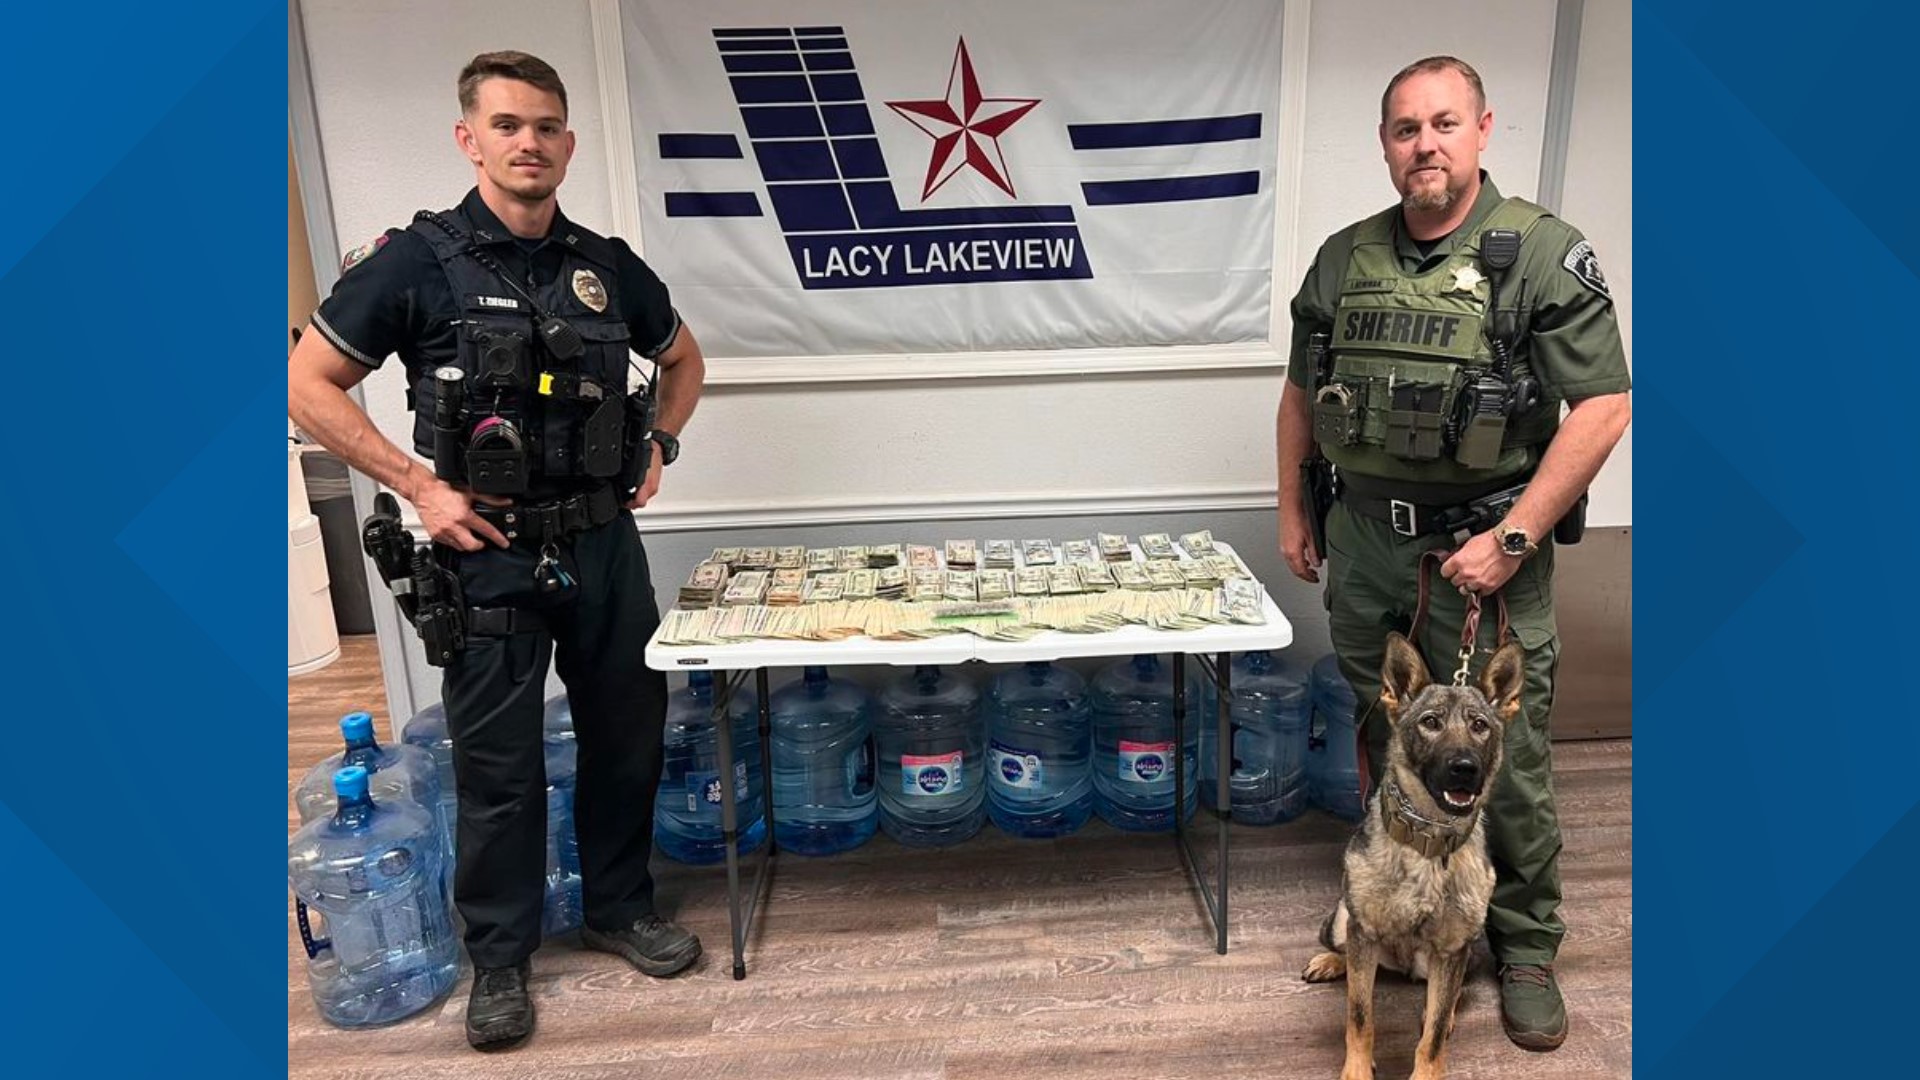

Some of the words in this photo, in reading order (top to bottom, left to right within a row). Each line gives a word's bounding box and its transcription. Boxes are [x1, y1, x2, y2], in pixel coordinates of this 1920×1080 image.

[803, 244, 893, 278] LACY
[904, 238, 1075, 274] LAKEVIEW
[1343, 311, 1460, 347] SHERIFF
